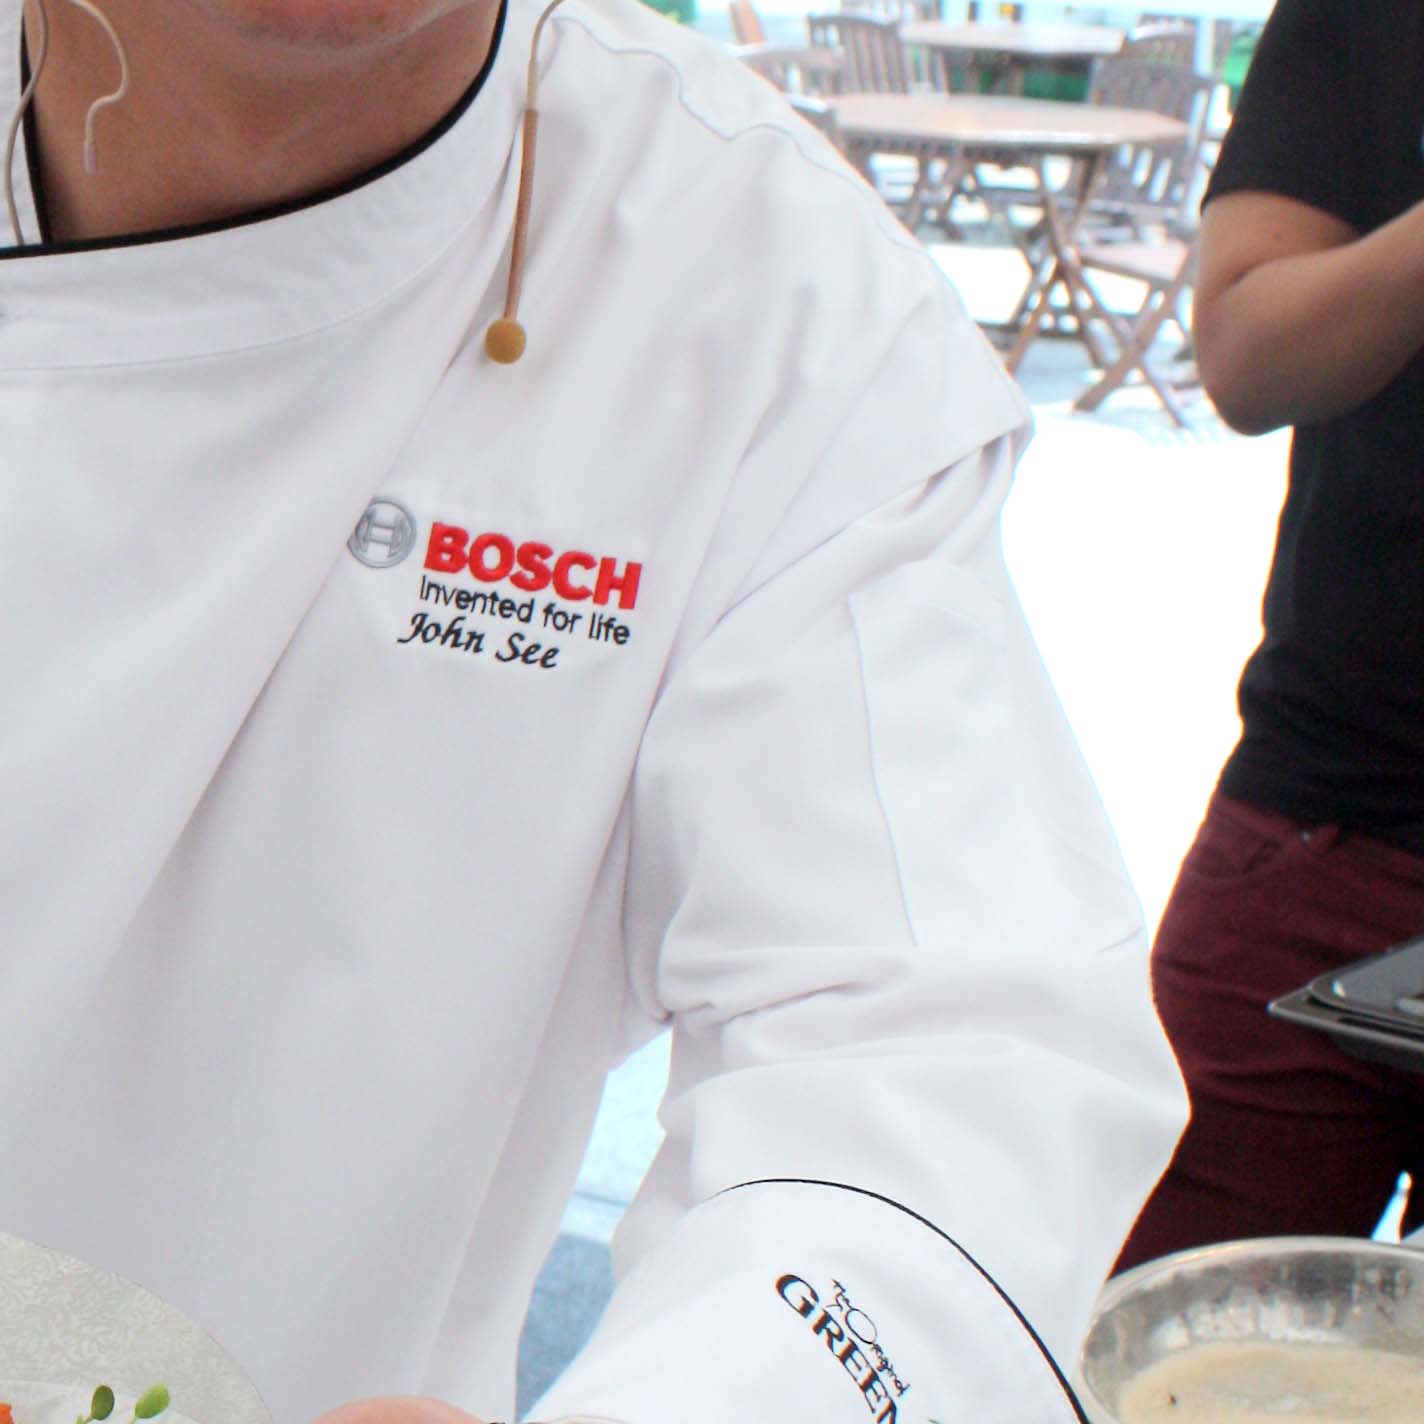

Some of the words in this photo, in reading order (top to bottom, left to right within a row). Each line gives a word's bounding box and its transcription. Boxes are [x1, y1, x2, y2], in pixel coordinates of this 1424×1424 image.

[424, 521, 643, 610] BOSCH
[397, 611, 486, 654] John
[494, 632, 560, 669] See
[419, 574, 535, 624] Invented
[542, 602, 583, 634] for
[588, 611, 631, 646] life
